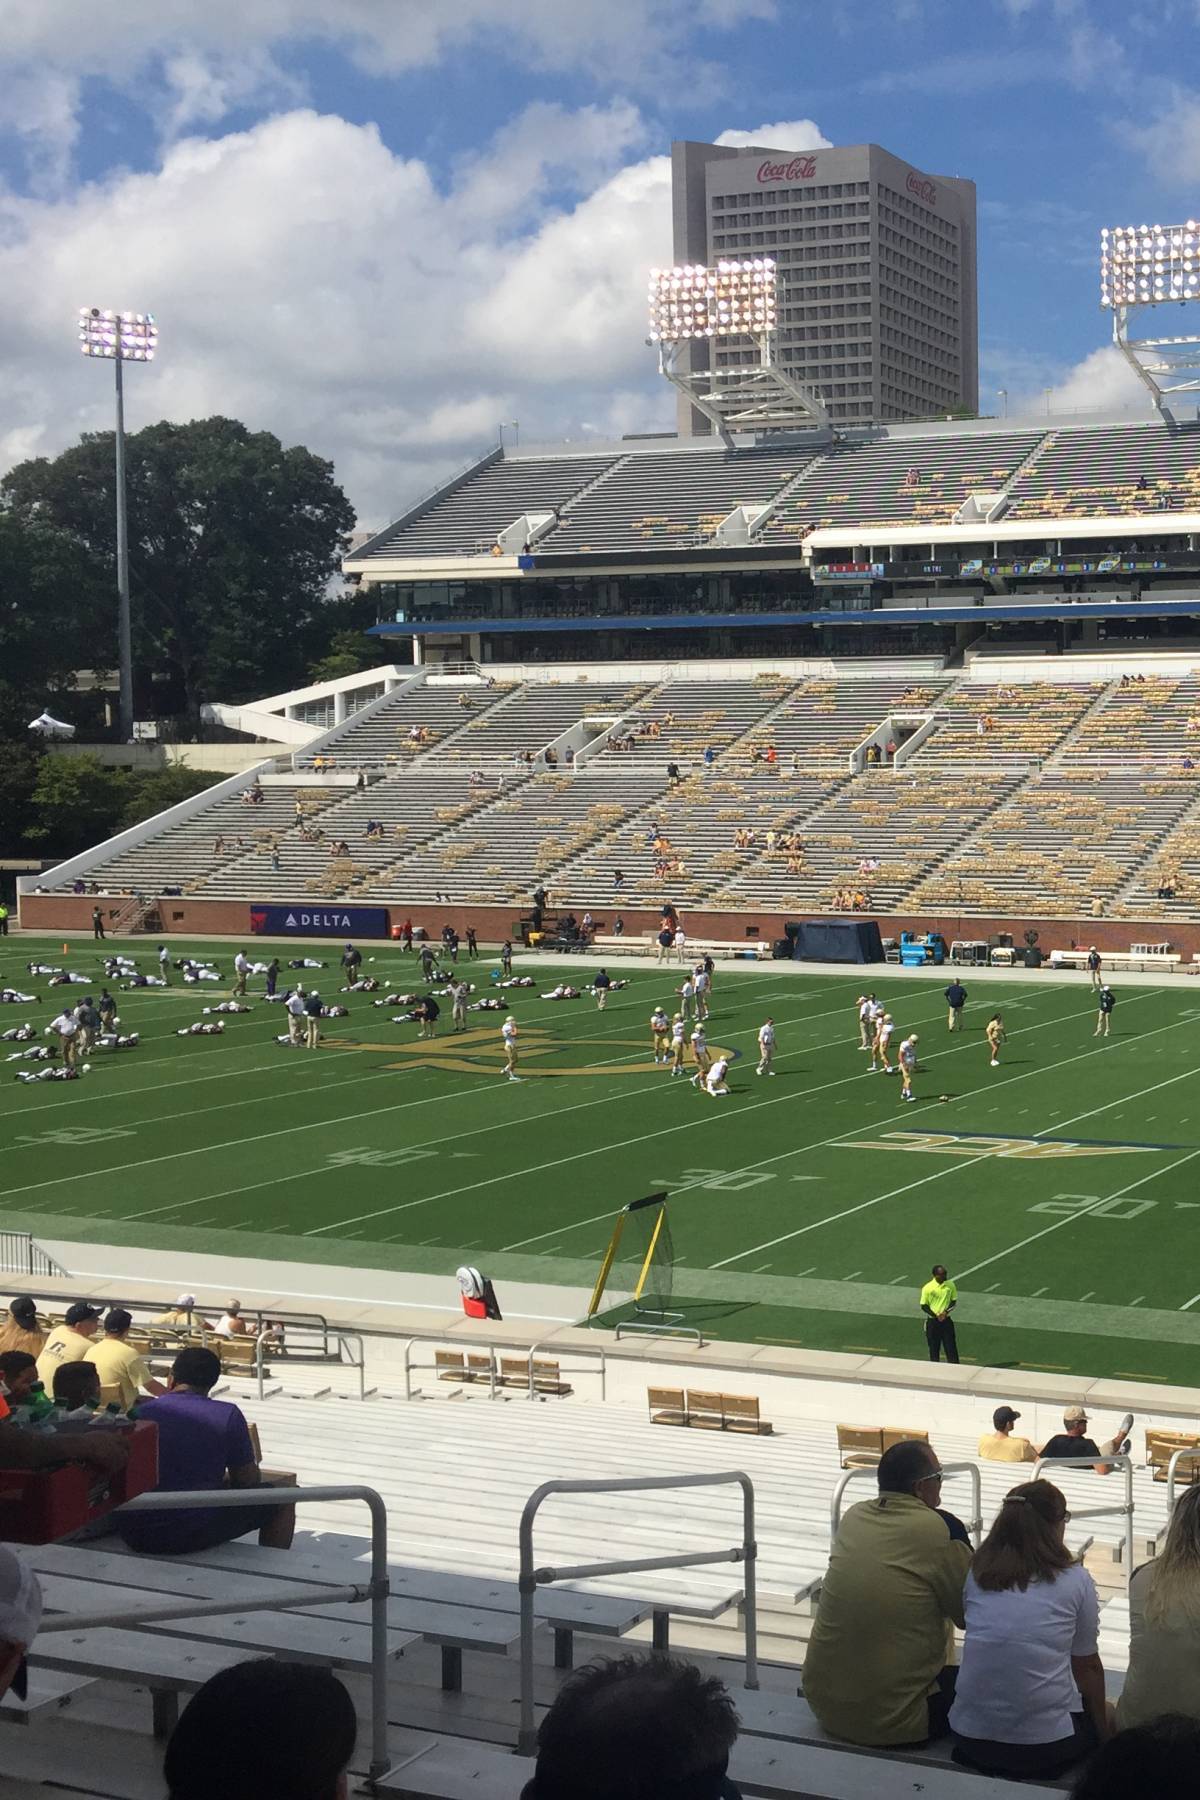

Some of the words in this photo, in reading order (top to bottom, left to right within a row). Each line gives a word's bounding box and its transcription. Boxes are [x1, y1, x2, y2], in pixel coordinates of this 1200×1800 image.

[301, 914, 351, 927] DELTA
[650, 1168, 778, 1191] 30
[1026, 1193, 1160, 1219] 20
